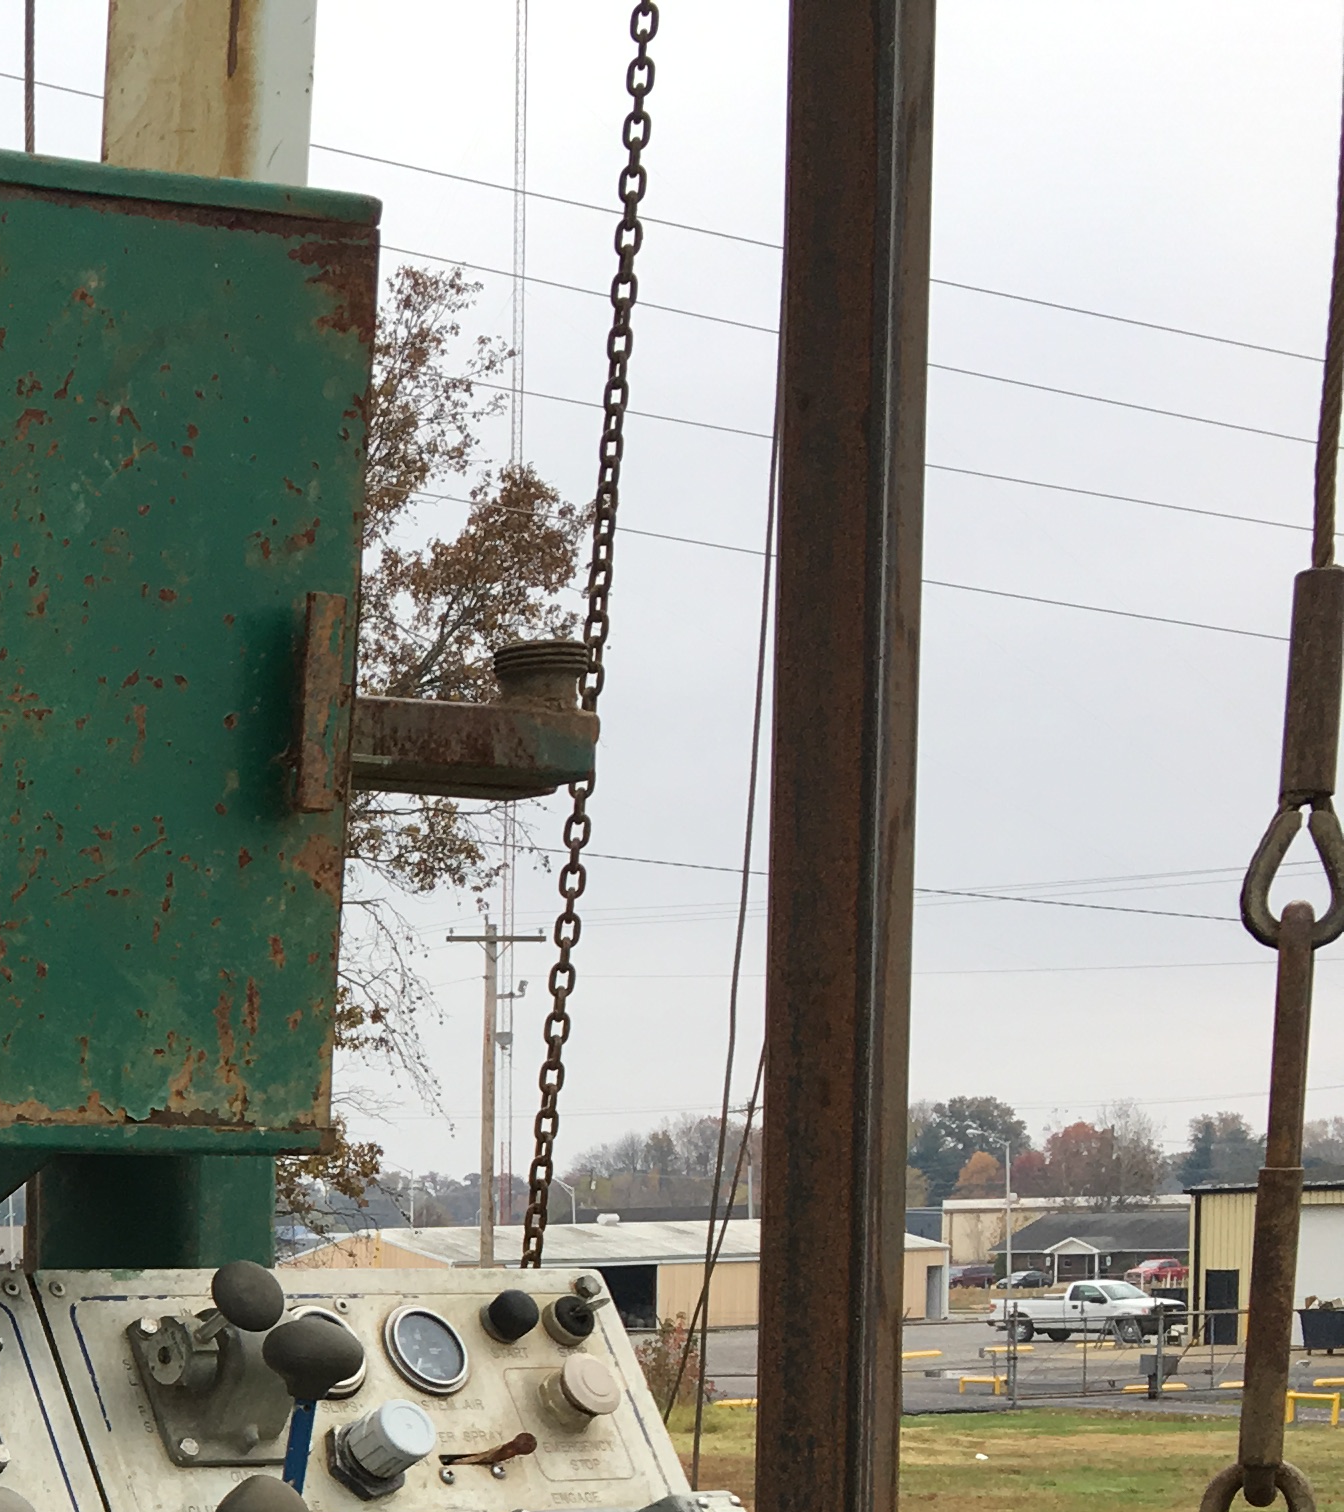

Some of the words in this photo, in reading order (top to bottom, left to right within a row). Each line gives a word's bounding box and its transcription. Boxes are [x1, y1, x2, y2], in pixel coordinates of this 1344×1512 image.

[490, 1347, 528, 1359] START
[321, 1402, 358, 1414] SLIPS
[465, 1398, 485, 1411] AIR
[462, 1430, 504, 1443] SPRAY
[543, 1440, 614, 1453] EMERGENCY
[571, 1457, 603, 1472] STOP
[550, 1490, 602, 1504] ENGAGE
